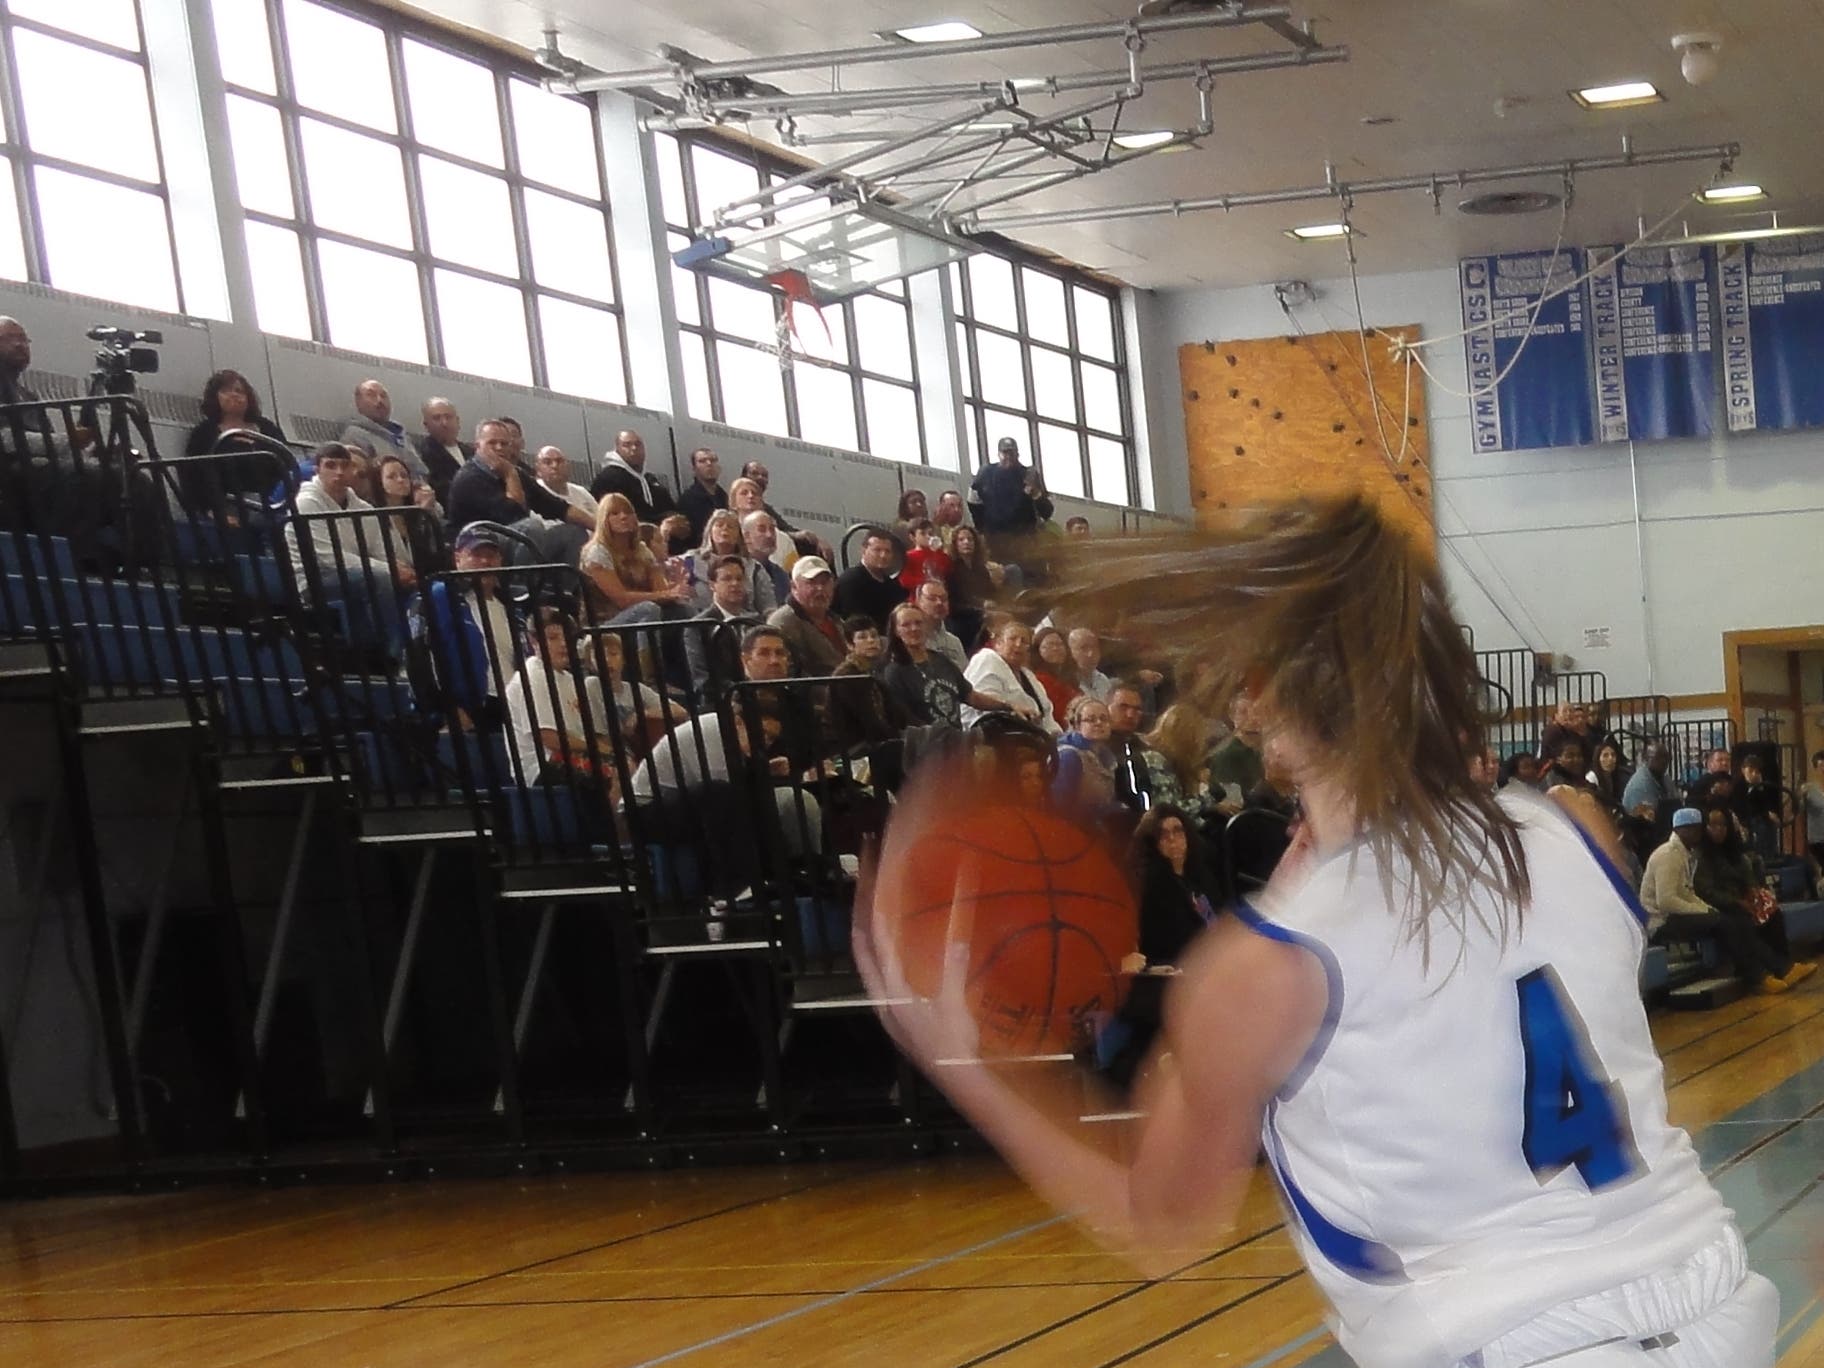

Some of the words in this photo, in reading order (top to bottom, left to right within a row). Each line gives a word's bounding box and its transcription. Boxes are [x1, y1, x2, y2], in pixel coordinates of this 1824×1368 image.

[1595, 275, 1616, 338] TRACK
[1723, 263, 1744, 327] TRACK
[1600, 344, 1621, 419] WINTER
[1728, 335, 1749, 407] SPRING
[1516, 963, 1651, 1195] 4
